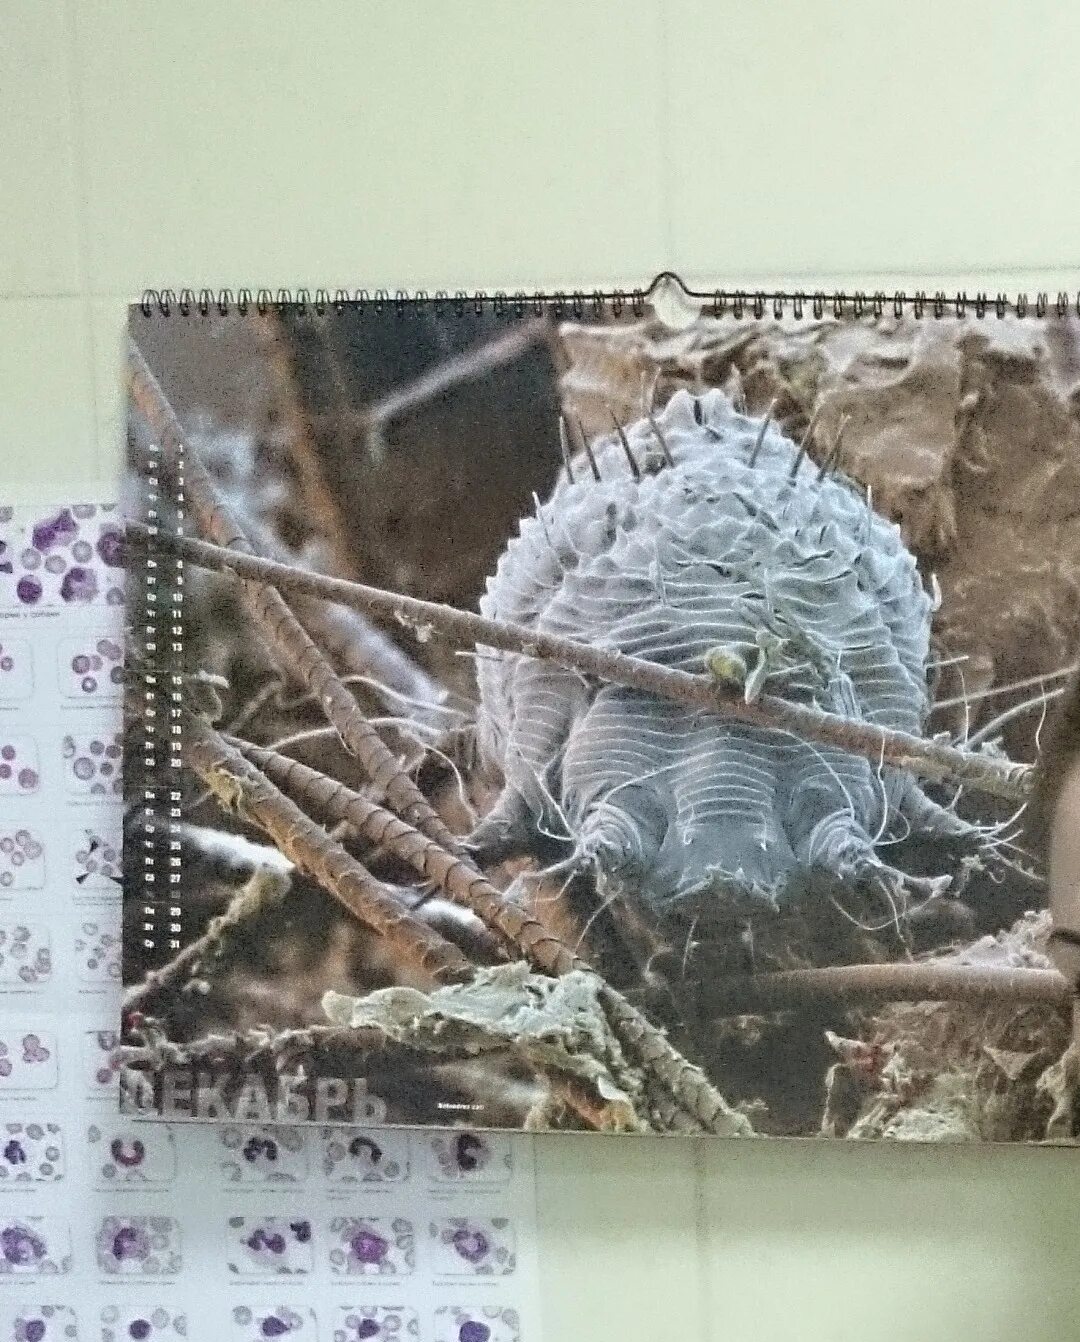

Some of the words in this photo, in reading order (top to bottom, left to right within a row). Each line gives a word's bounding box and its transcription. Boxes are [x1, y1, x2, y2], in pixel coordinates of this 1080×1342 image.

[178, 461, 184, 469] 2
[178, 493, 184, 501] 4
[177, 560, 183, 569] 8
[177, 576, 183, 585] 9
[172, 593, 183, 602] 10
[172, 610, 182, 618] 11
[172, 626, 183, 635] 12
[172, 643, 183, 652] 13
[172, 675, 182, 685] 15
[172, 692, 182, 701] 16
[171, 709, 182, 718] 17
[172, 725, 182, 734] 18
[172, 742, 182, 751] 19
[171, 758, 182, 767] 20
[170, 791, 181, 800] 22
[171, 808, 181, 817] 23
[170, 841, 181, 850] 25
[170, 857, 181, 867] 26
[170, 874, 181, 883] 27
[170, 906, 181, 916] 29
[170, 923, 181, 932] 30
[170, 939, 180, 949] 31
[119, 1070, 388, 1124] ДЕКАБРЬ
